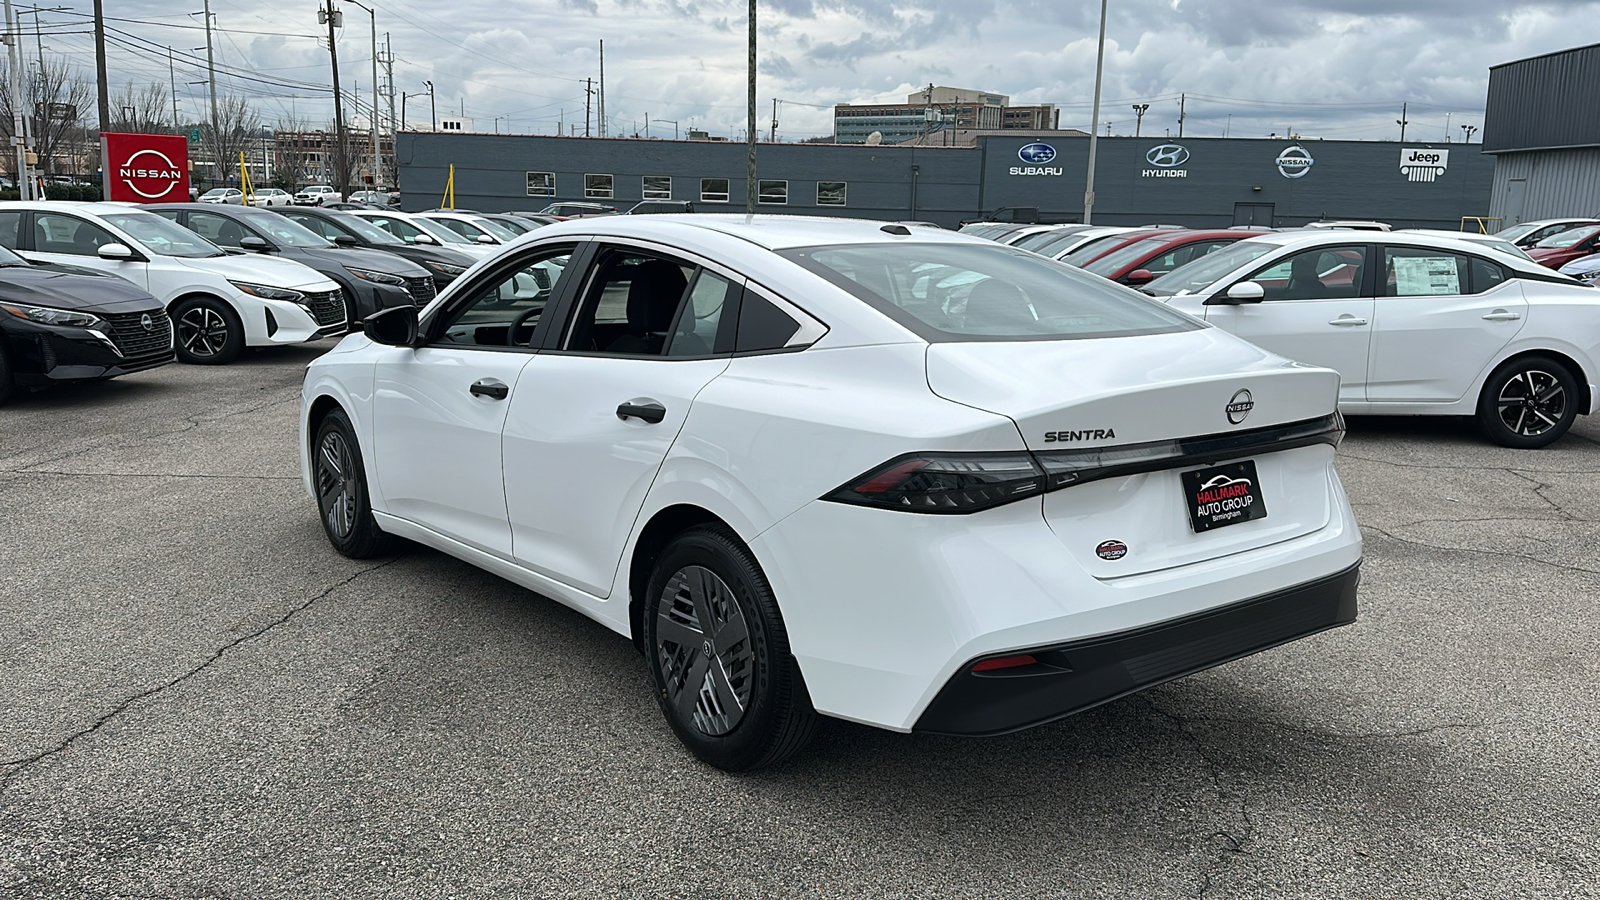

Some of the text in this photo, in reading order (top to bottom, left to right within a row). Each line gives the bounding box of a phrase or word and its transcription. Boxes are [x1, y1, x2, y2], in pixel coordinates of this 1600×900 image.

[1408, 151, 1440, 164] Jeep
[120, 168, 181, 179] NISSAN
[1009, 167, 1063, 176] SUBARU
[1142, 169, 1188, 178] HYUNDAI
[1227, 403, 1253, 412] NISSAN
[1044, 428, 1115, 443] SENTRA
[1196, 483, 1249, 505] HALLMARK
[1197, 495, 1254, 517] AUTO GROUP
[1212, 510, 1242, 522] Birmingham
